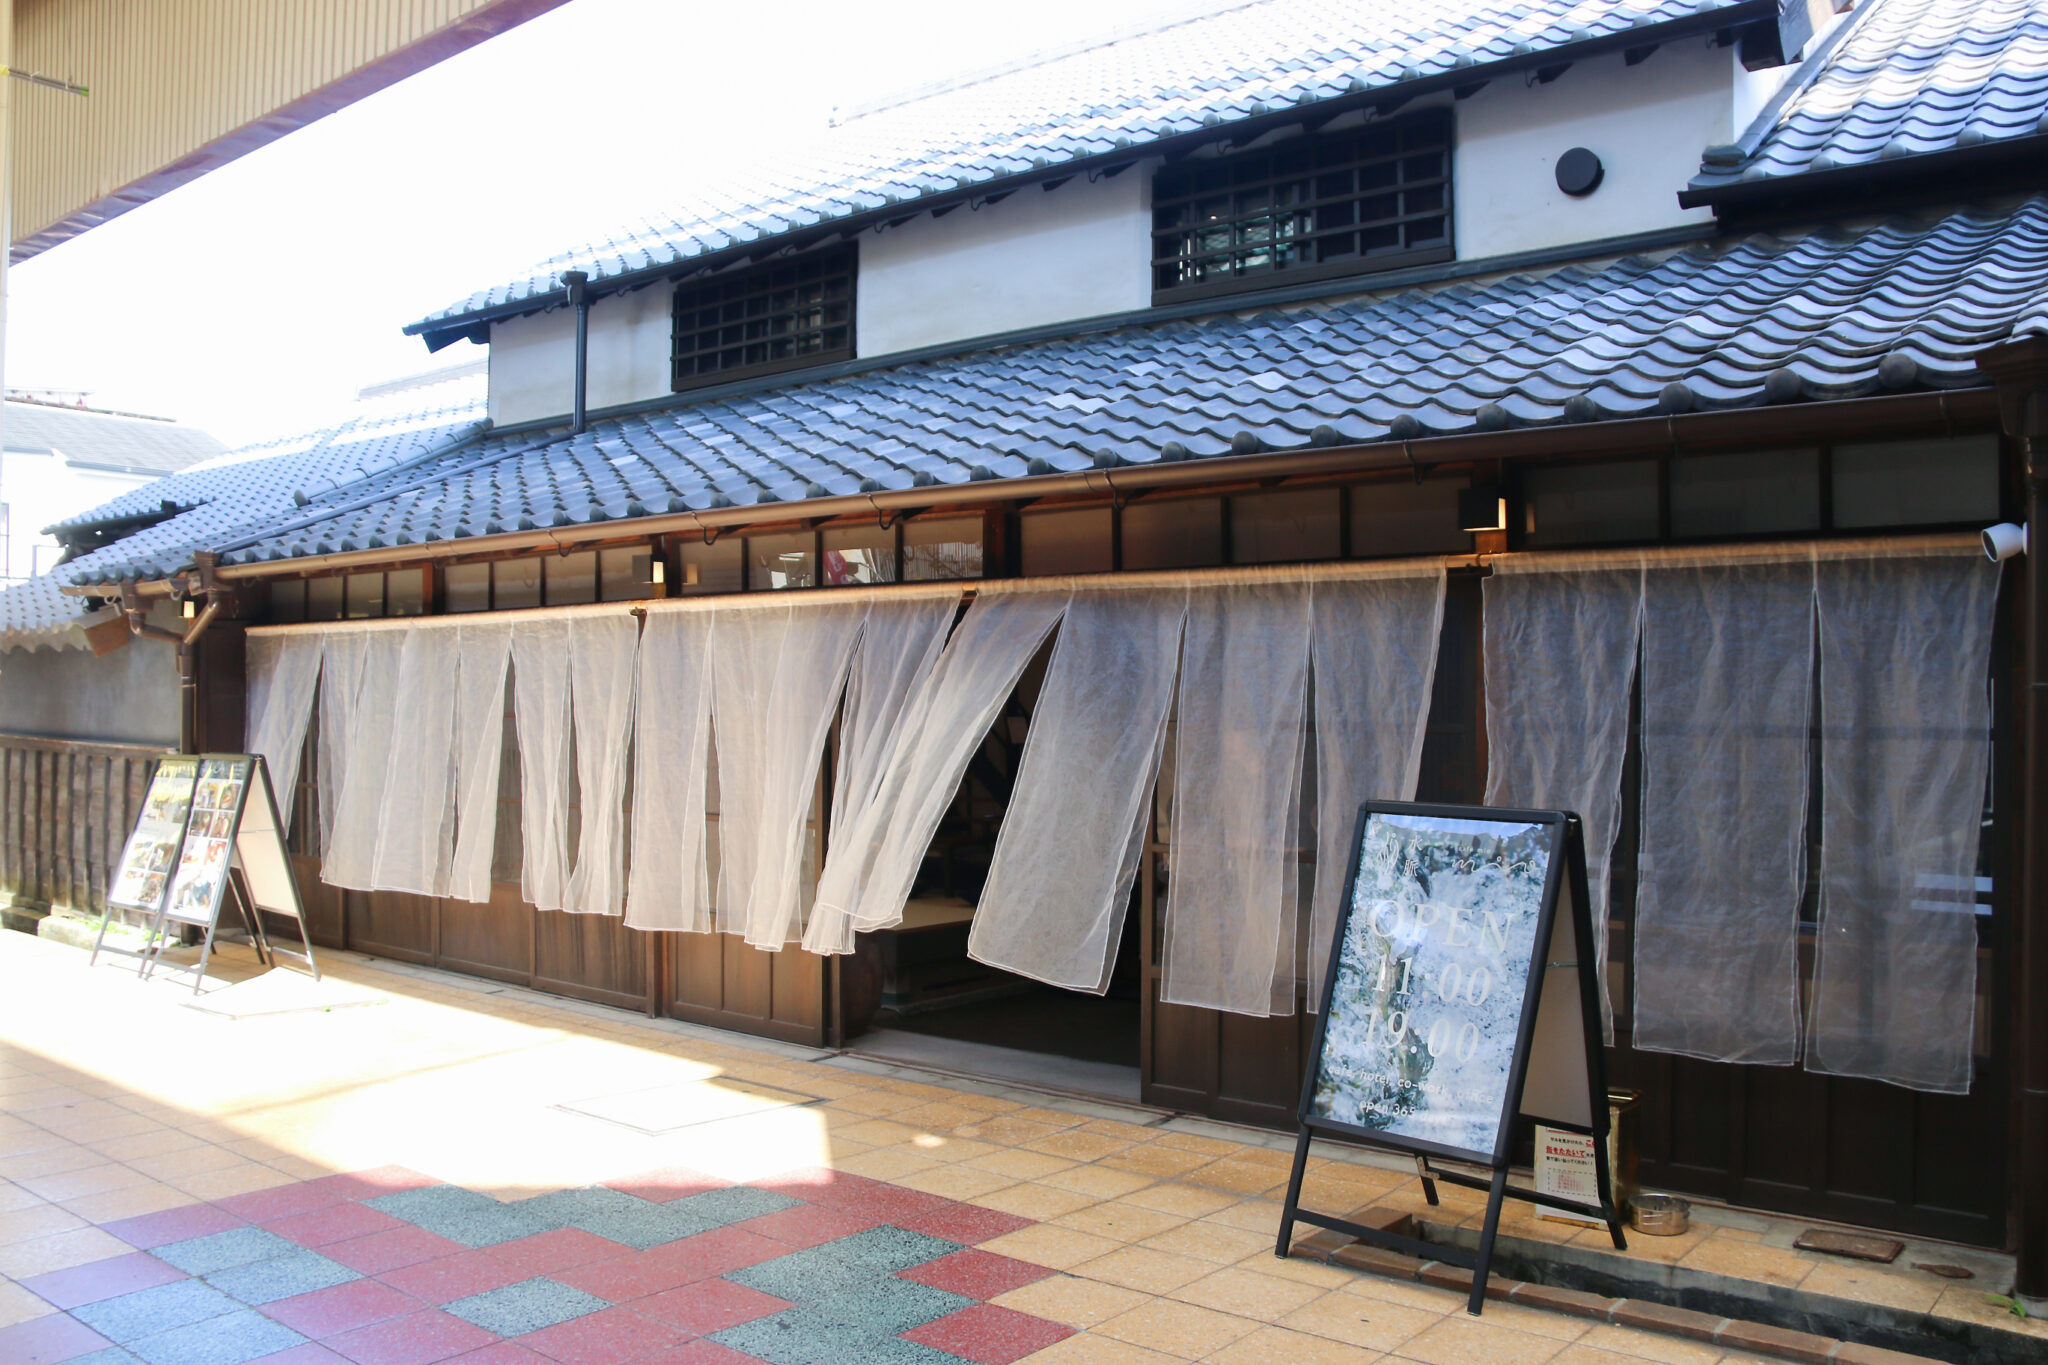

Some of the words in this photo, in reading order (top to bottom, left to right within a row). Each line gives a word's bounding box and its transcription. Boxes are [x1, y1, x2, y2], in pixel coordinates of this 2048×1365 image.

[1370, 900, 1518, 953] OPEN
[1372, 953, 1491, 1007] 11:00
[1362, 1007, 1479, 1063] 19:00
[1392, 1104, 1416, 1118] 365
